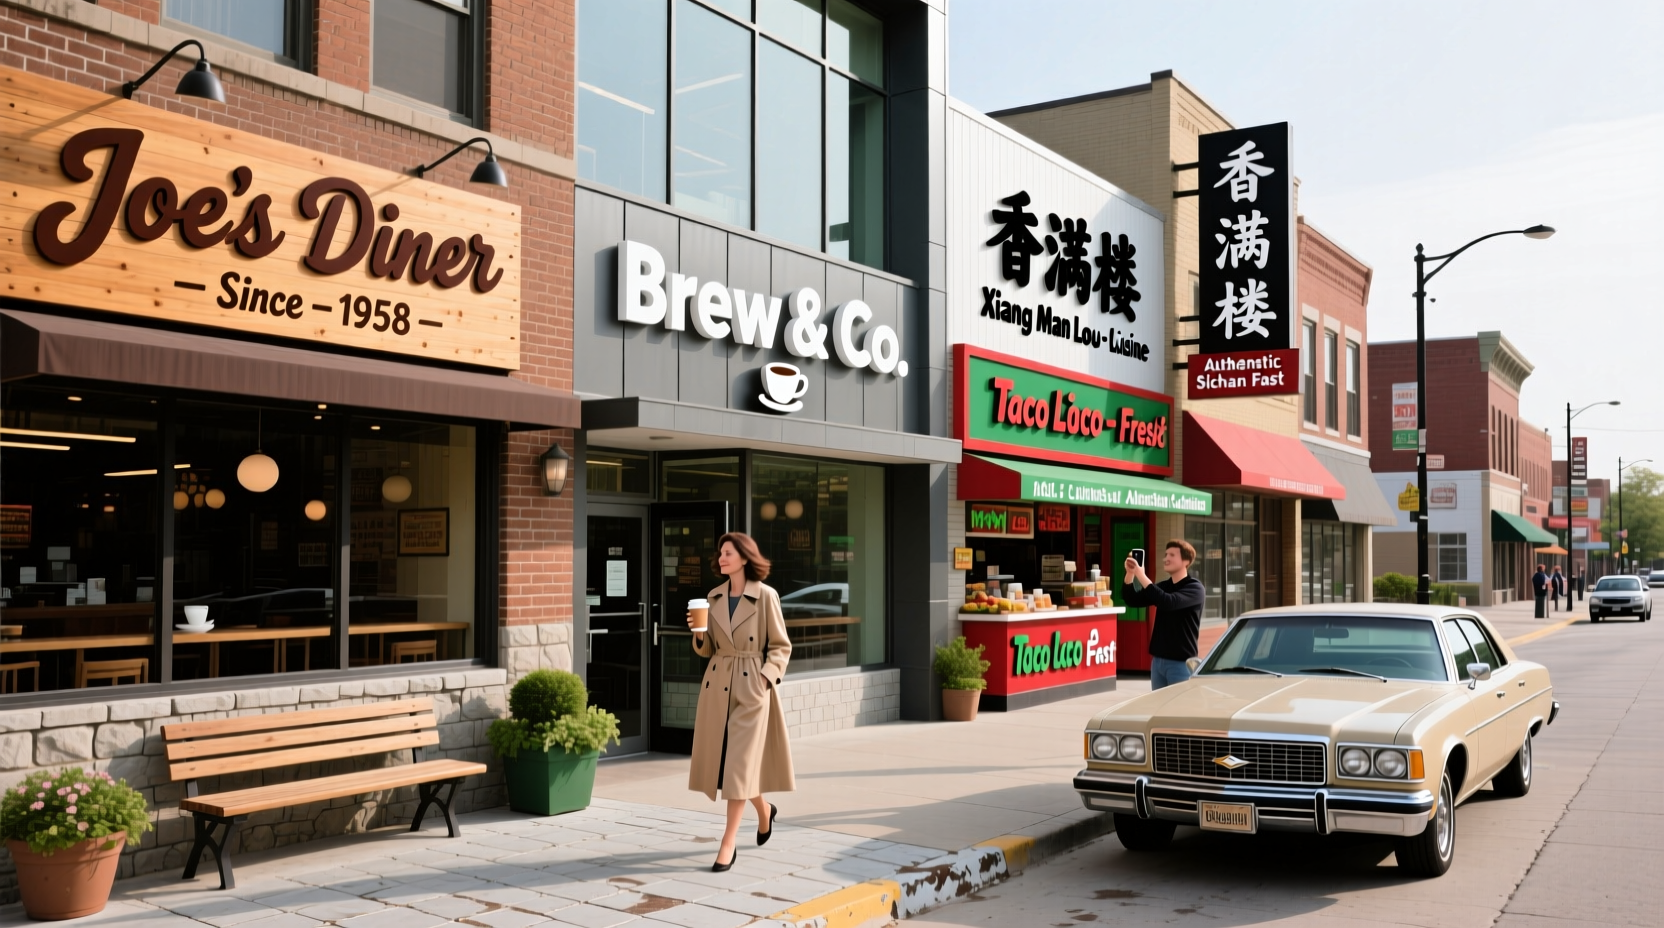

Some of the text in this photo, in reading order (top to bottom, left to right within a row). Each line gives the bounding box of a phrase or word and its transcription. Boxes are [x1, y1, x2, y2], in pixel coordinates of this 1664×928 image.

[33, 127, 504, 294] Joe's Diner
[986, 190, 1142, 323] 香满楼
[1213, 140, 1277, 340] 香满楼
[216, 271, 411, 336] Since 1958
[617, 240, 783, 349] Brew
[832, 299, 909, 378] Co.
[980, 286, 1033, 336] Xiang
[1036, 304, 1071, 339] Man
[994, 376, 1050, 429] Taco
[1251, 370, 1285, 388] Fast
